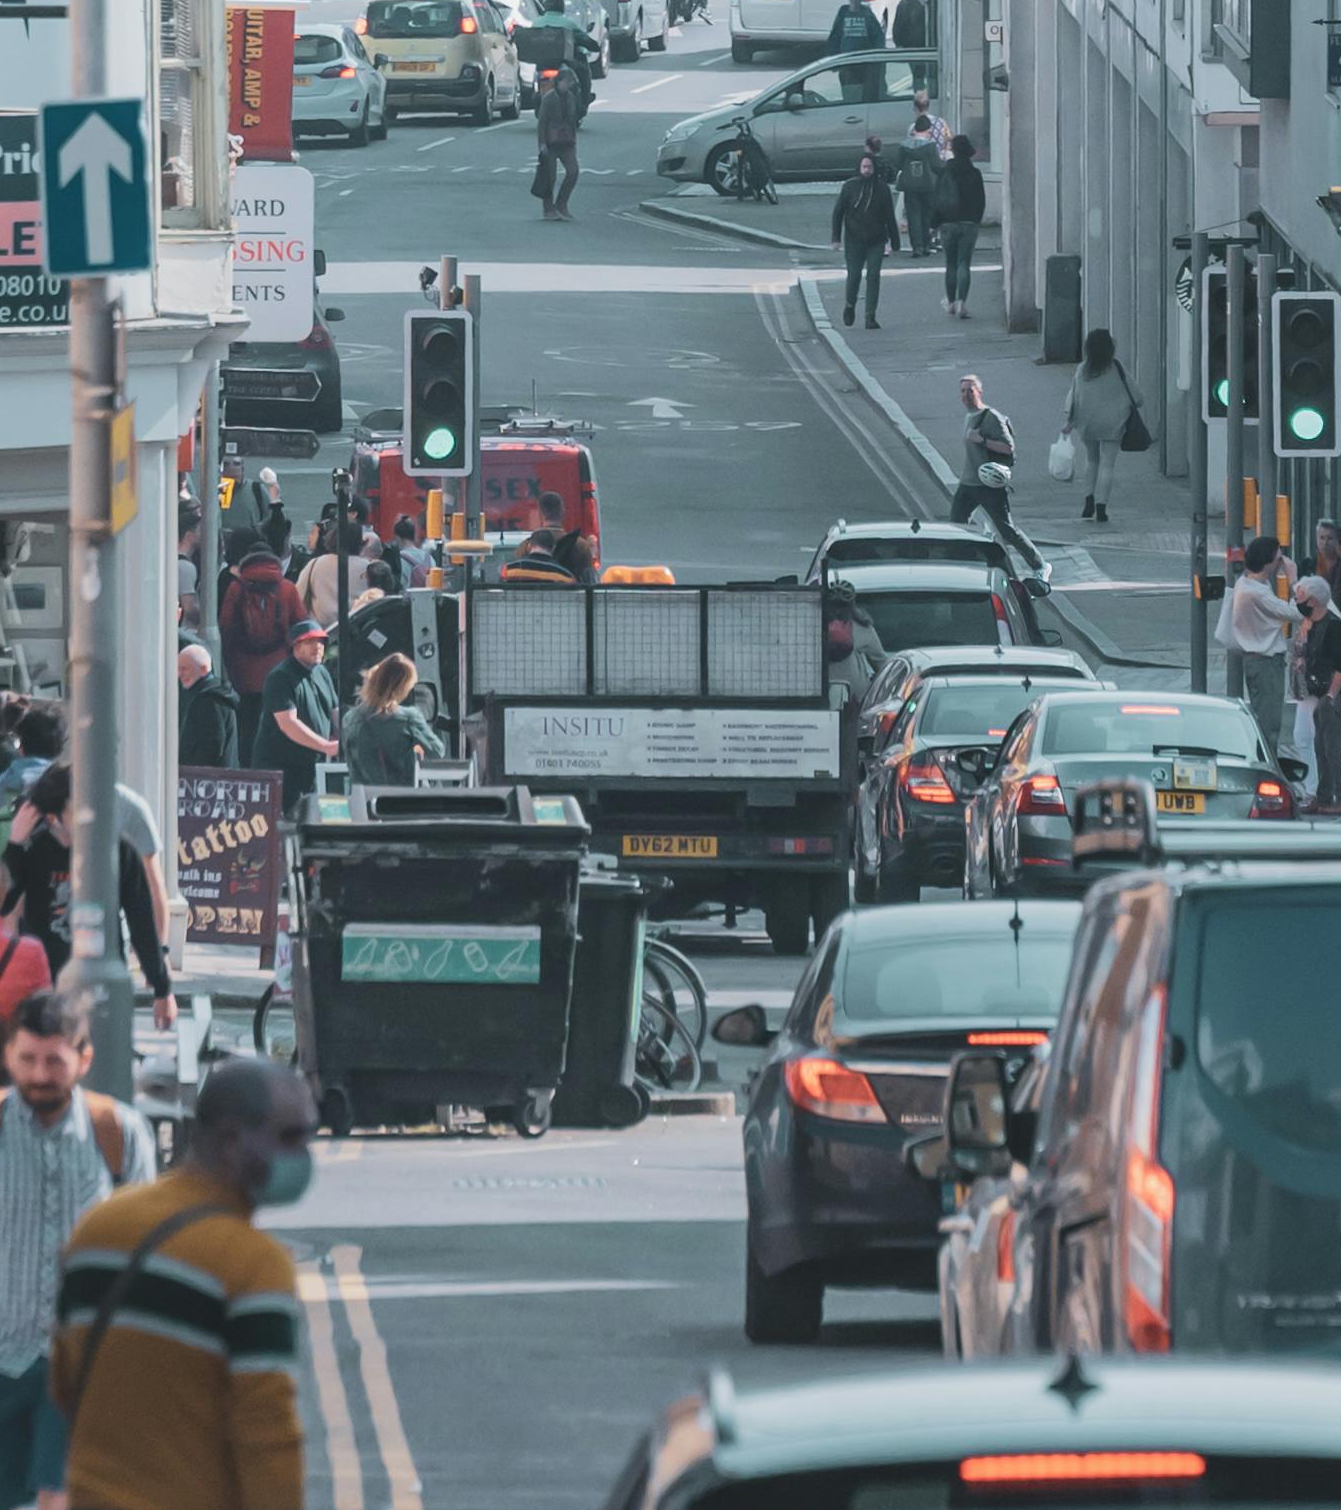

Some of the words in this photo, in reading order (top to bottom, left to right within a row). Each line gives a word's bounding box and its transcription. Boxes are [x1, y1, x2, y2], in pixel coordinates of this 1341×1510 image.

[241, 9, 264, 65] UITAR,
[243, 69, 262, 109] AMP
[243, 113, 261, 126] &
[542, 716, 624, 737] INSITU
[178, 777, 270, 802] NORTH
[178, 799, 246, 819] ROAD
[1163, 793, 1195, 810] UWB
[178, 813, 269, 865] tattoo
[629, 836, 674, 853] DY62
[678, 836, 710, 853] MTU
